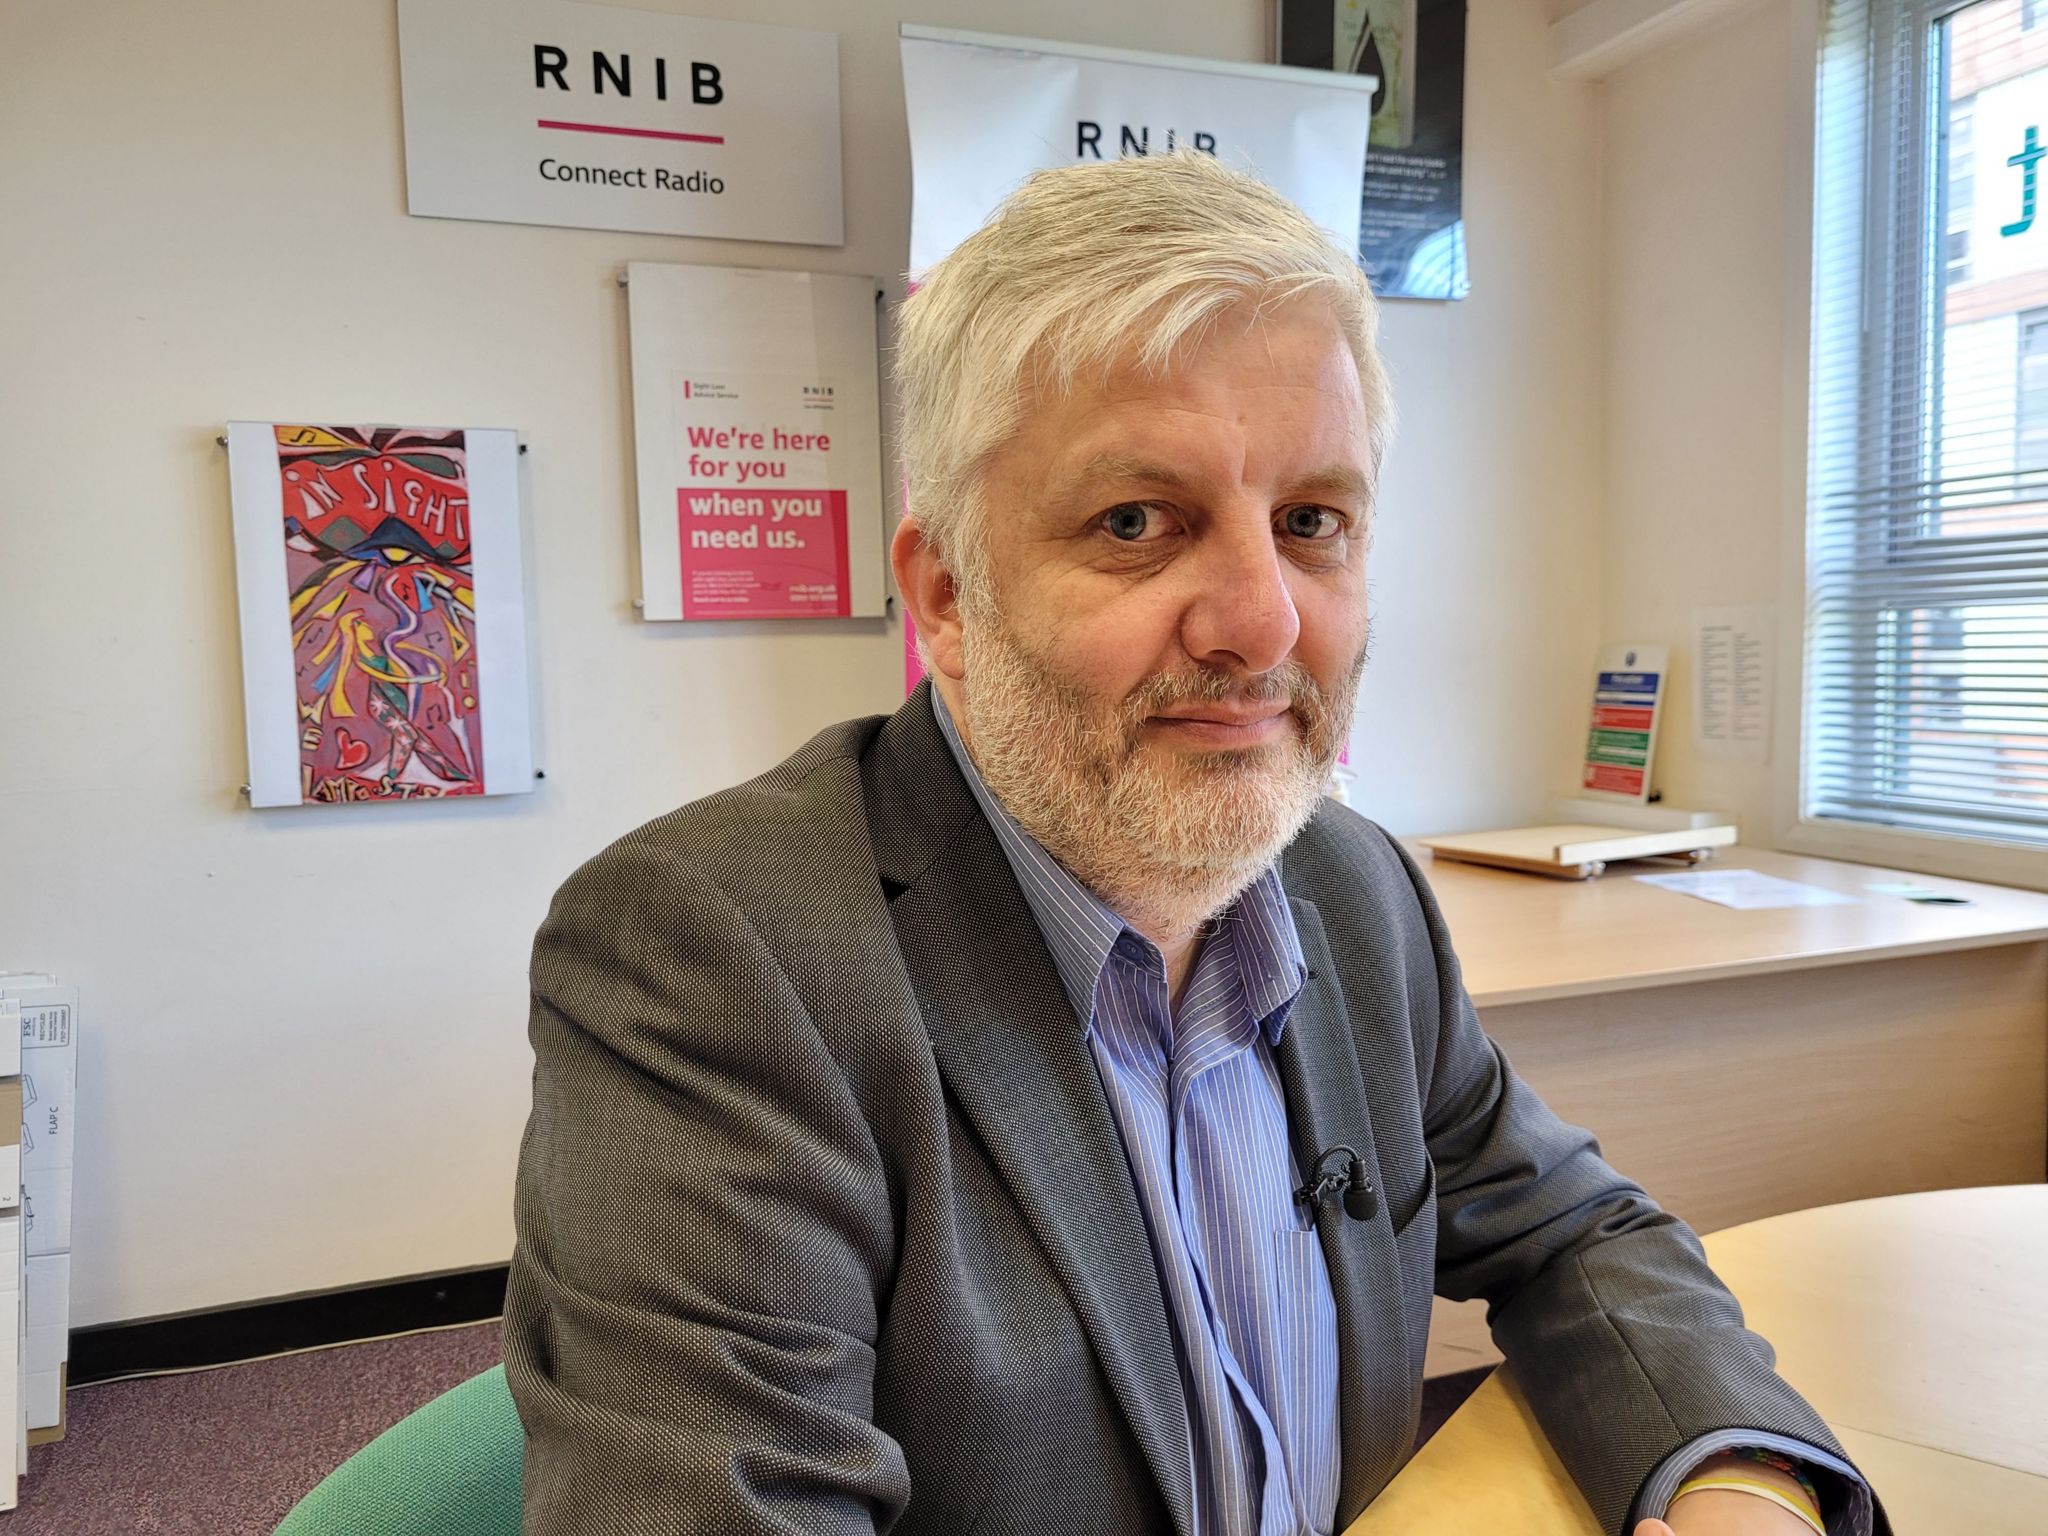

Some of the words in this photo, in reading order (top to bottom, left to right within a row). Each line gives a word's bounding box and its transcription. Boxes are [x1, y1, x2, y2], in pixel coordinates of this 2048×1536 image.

[533, 44, 725, 105] RNIB
[539, 157, 647, 189] Connect
[655, 168, 725, 194] Radio
[803, 386, 834, 396] RNIB
[687, 426, 764, 449] We're
[773, 428, 831, 451] here
[688, 454, 729, 477] for
[736, 461, 786, 483] you
[689, 492, 764, 516] when
[771, 497, 822, 522] you
[692, 524, 758, 549] need
[766, 531, 806, 549] us.
[23, 1018, 32, 1037] FSC
[49, 1114, 58, 1135] FLAP
